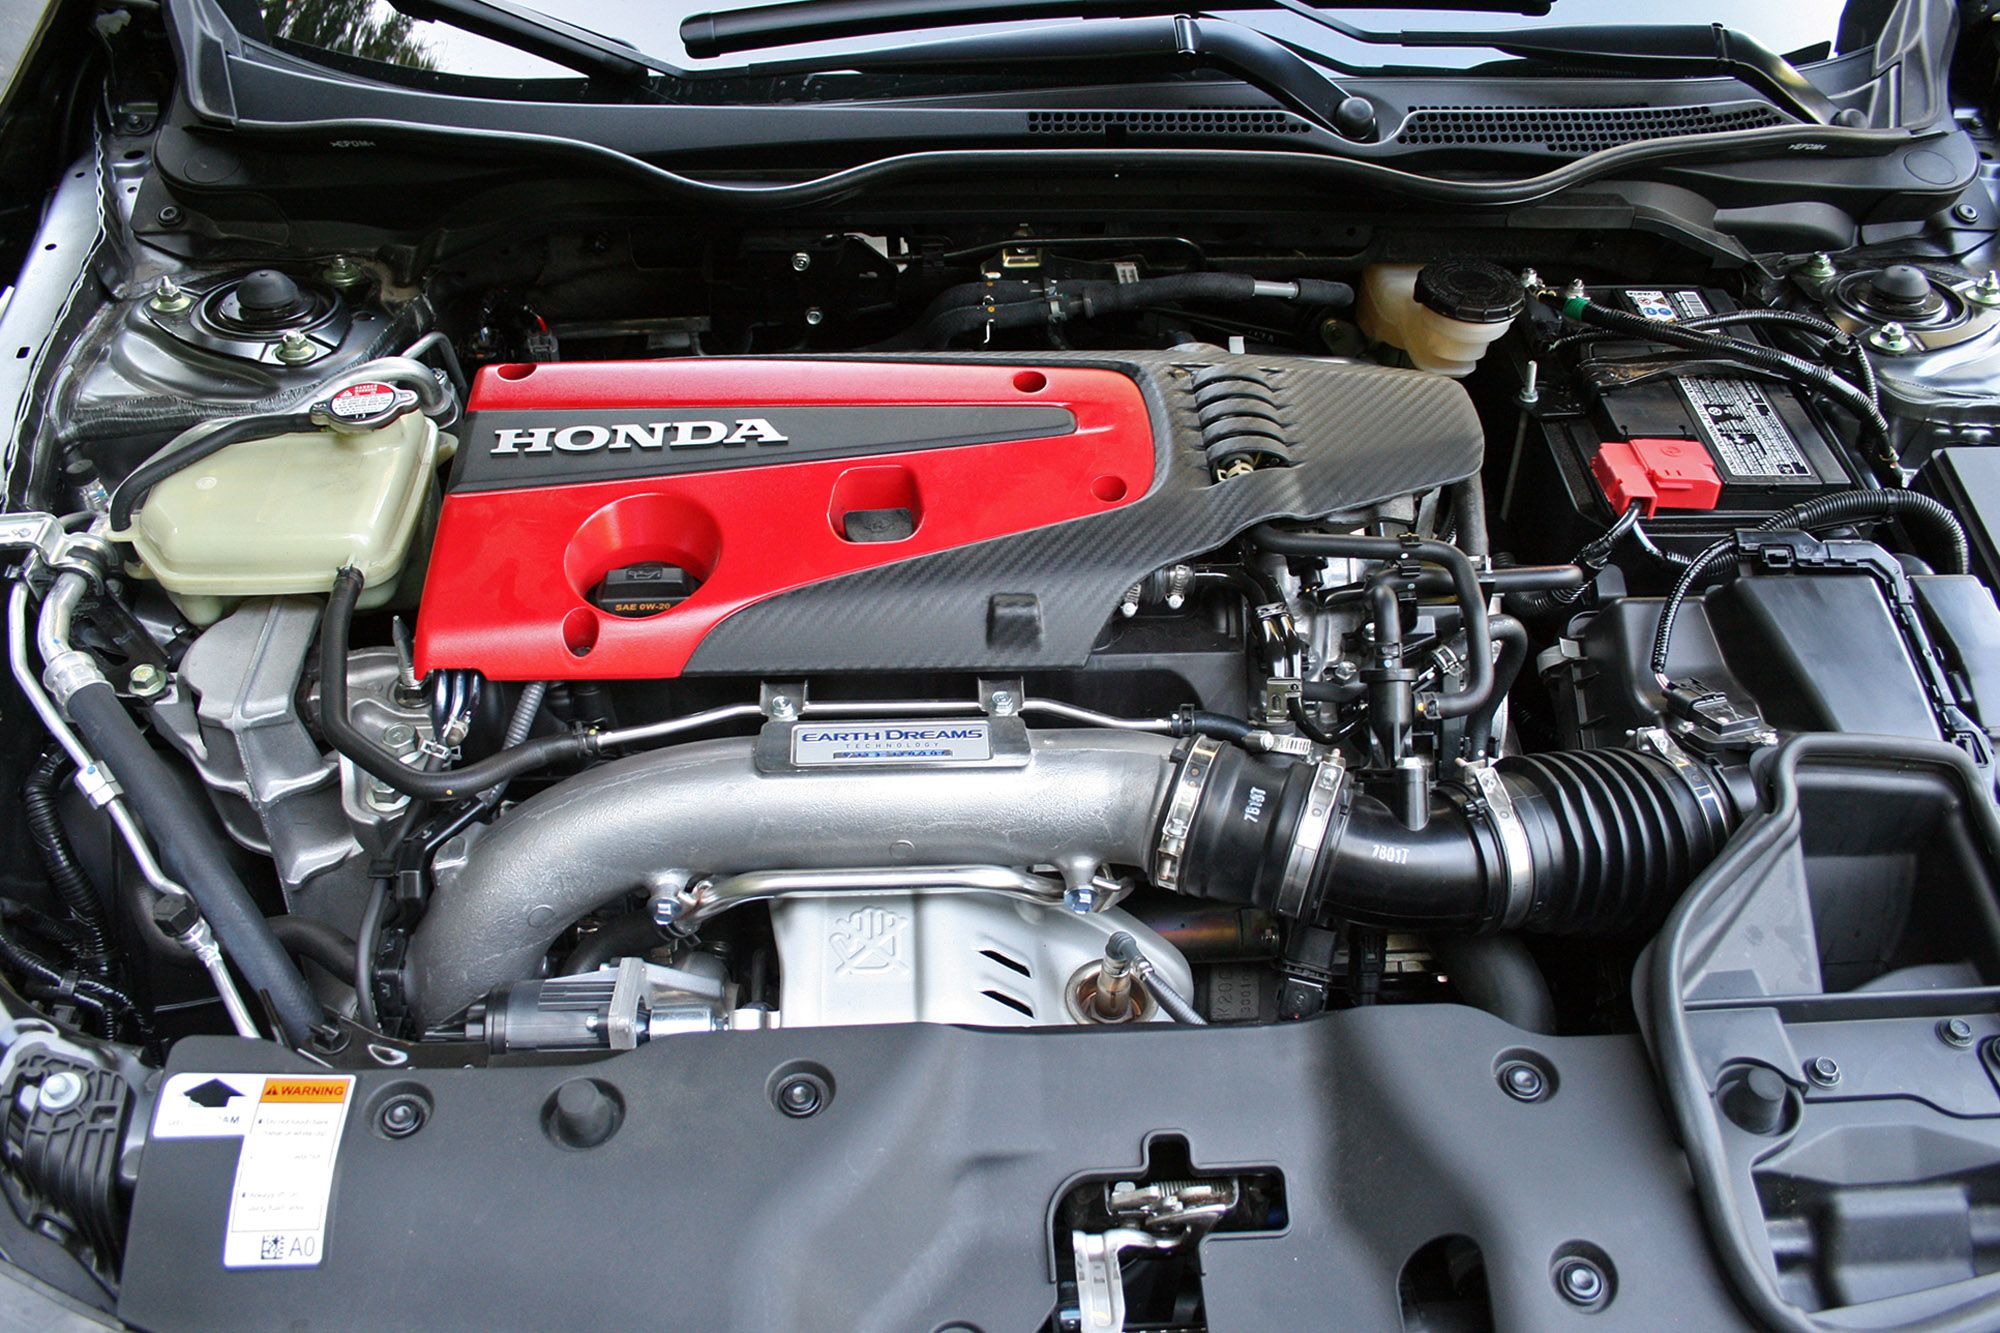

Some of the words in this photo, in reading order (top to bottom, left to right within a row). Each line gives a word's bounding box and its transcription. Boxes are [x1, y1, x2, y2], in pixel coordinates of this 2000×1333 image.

[490, 417, 789, 454] HONDA
[615, 602, 638, 612] SAE
[639, 602, 672, 611] 0W-20
[801, 732, 880, 742] EARTH
[885, 729, 983, 741] DREAMS
[845, 741, 940, 749] TECHNOLOGY
[280, 1085, 344, 1097] WARNING
[288, 1235, 316, 1258] A0
